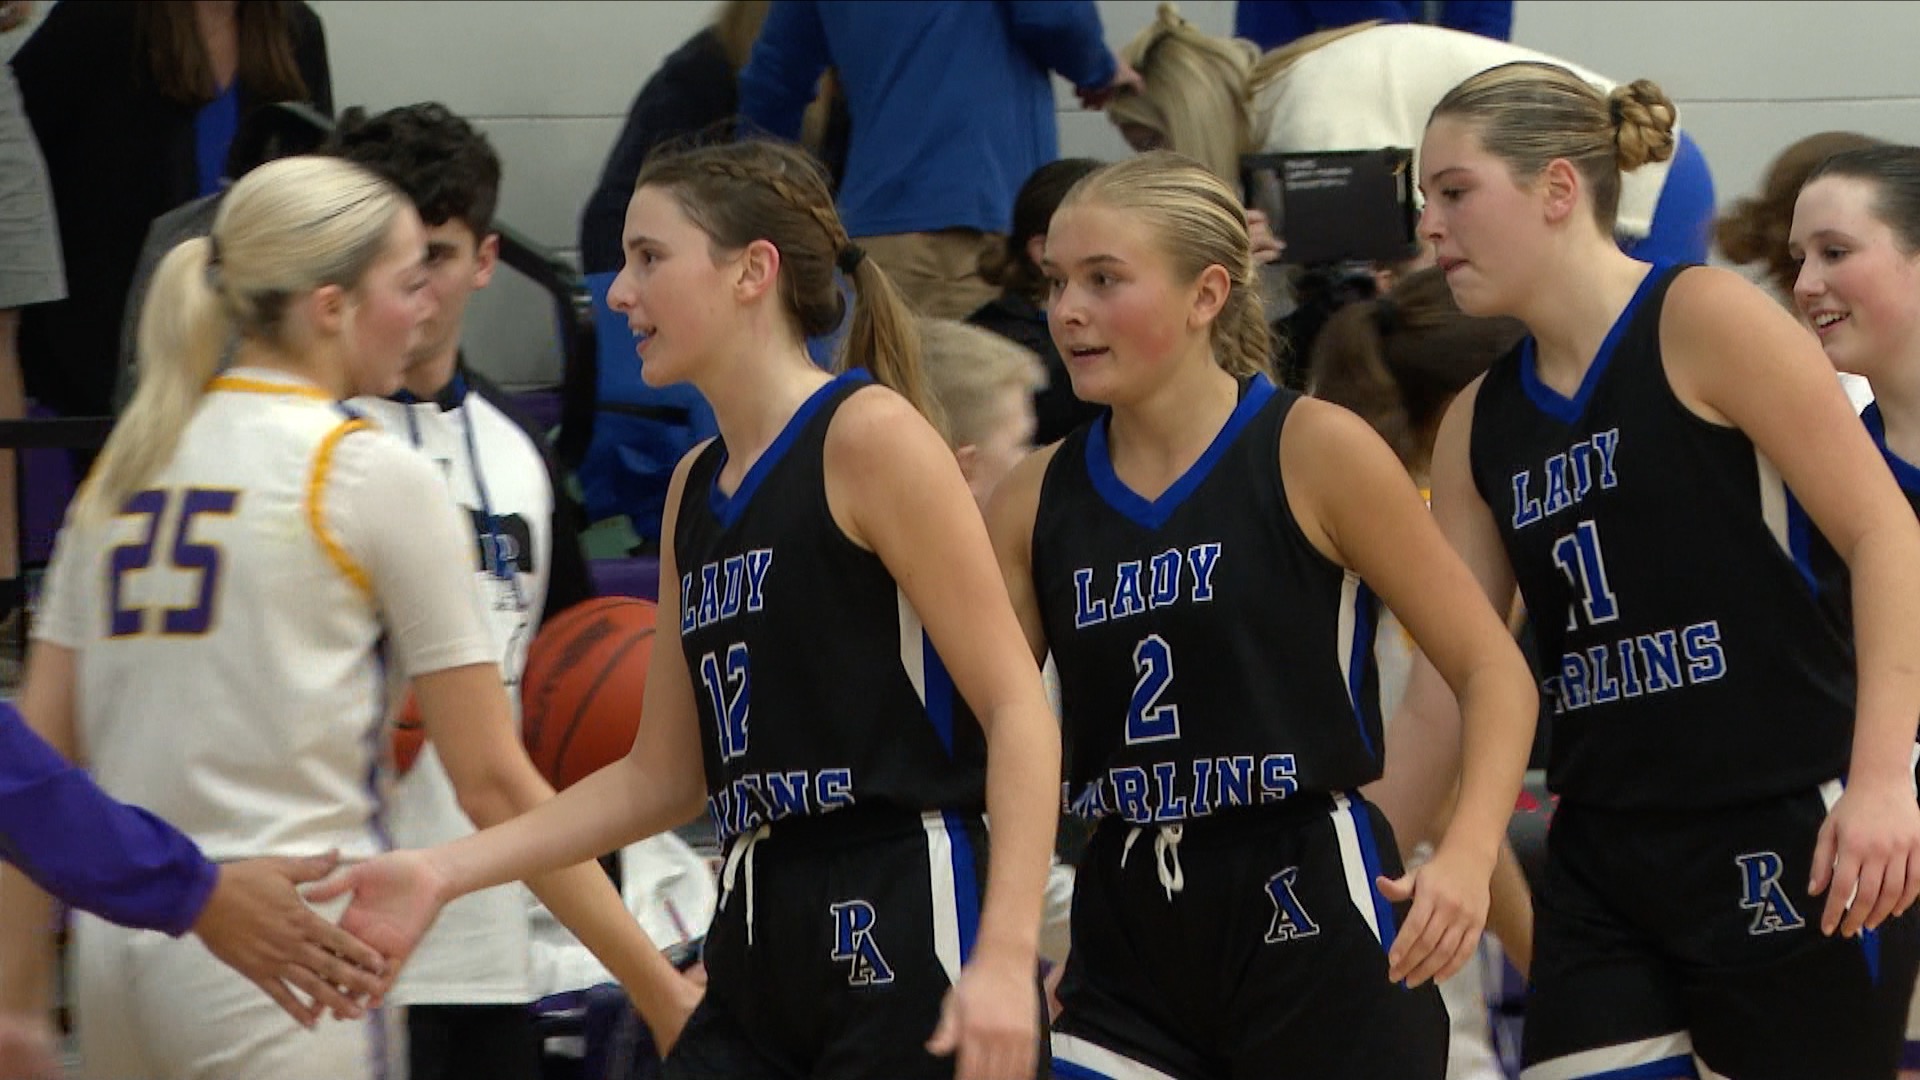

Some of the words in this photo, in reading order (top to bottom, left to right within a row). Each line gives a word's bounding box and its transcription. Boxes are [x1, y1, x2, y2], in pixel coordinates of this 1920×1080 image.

[105, 487, 240, 639] 25
[681, 548, 773, 637] LADY
[1074, 542, 1222, 629] LADY
[700, 642, 752, 763] 12
[1125, 634, 1181, 746] 2
[1063, 753, 1299, 824] ARLINS
[830, 899, 895, 986] PA
